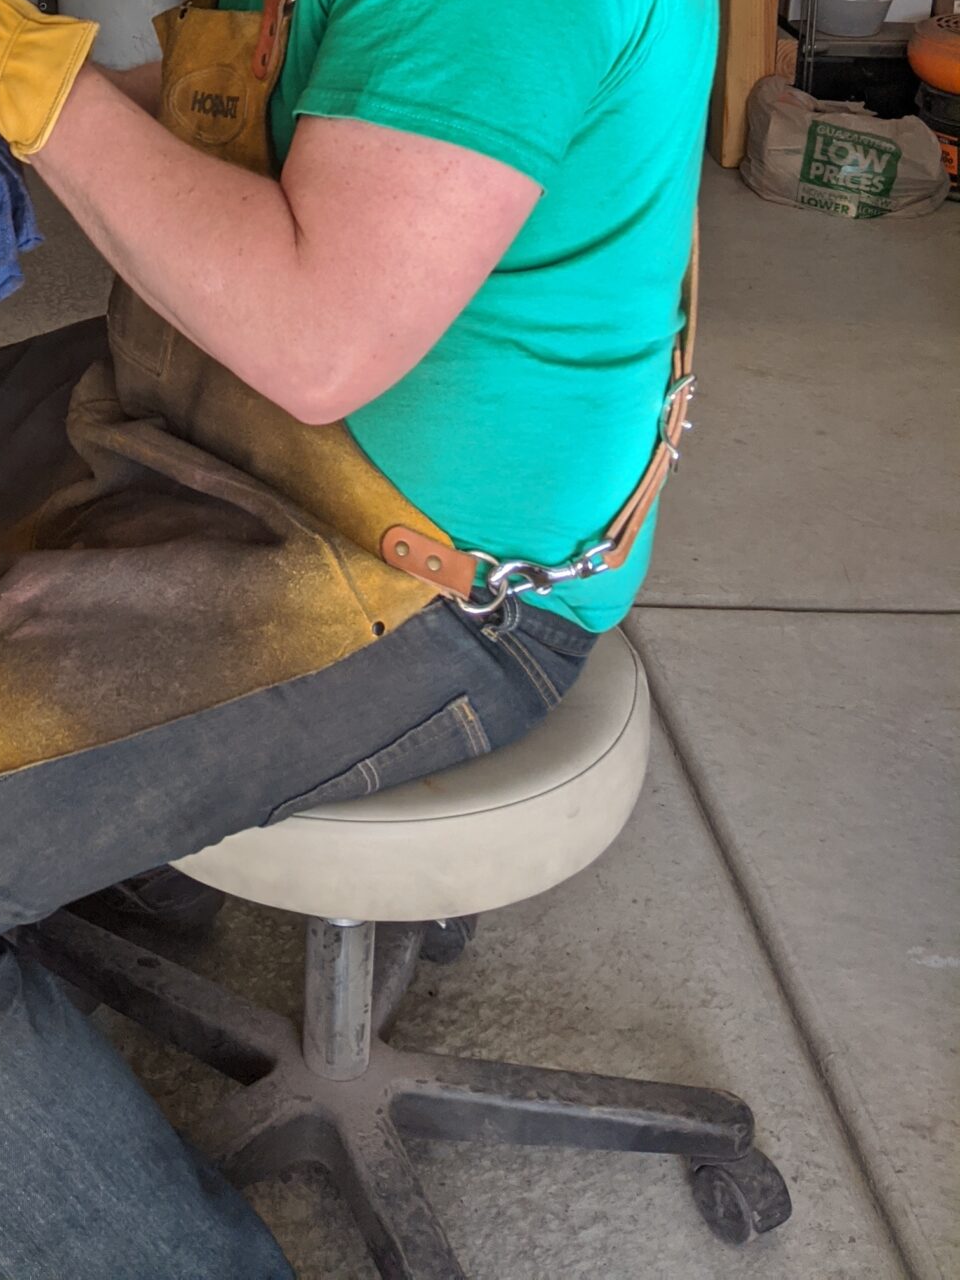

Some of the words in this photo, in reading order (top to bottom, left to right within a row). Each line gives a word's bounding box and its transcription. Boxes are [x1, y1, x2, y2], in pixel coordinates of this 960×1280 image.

[814, 135, 890, 173] LOW
[809, 162, 885, 193] PRICES
[800, 195, 850, 215] LOWER
